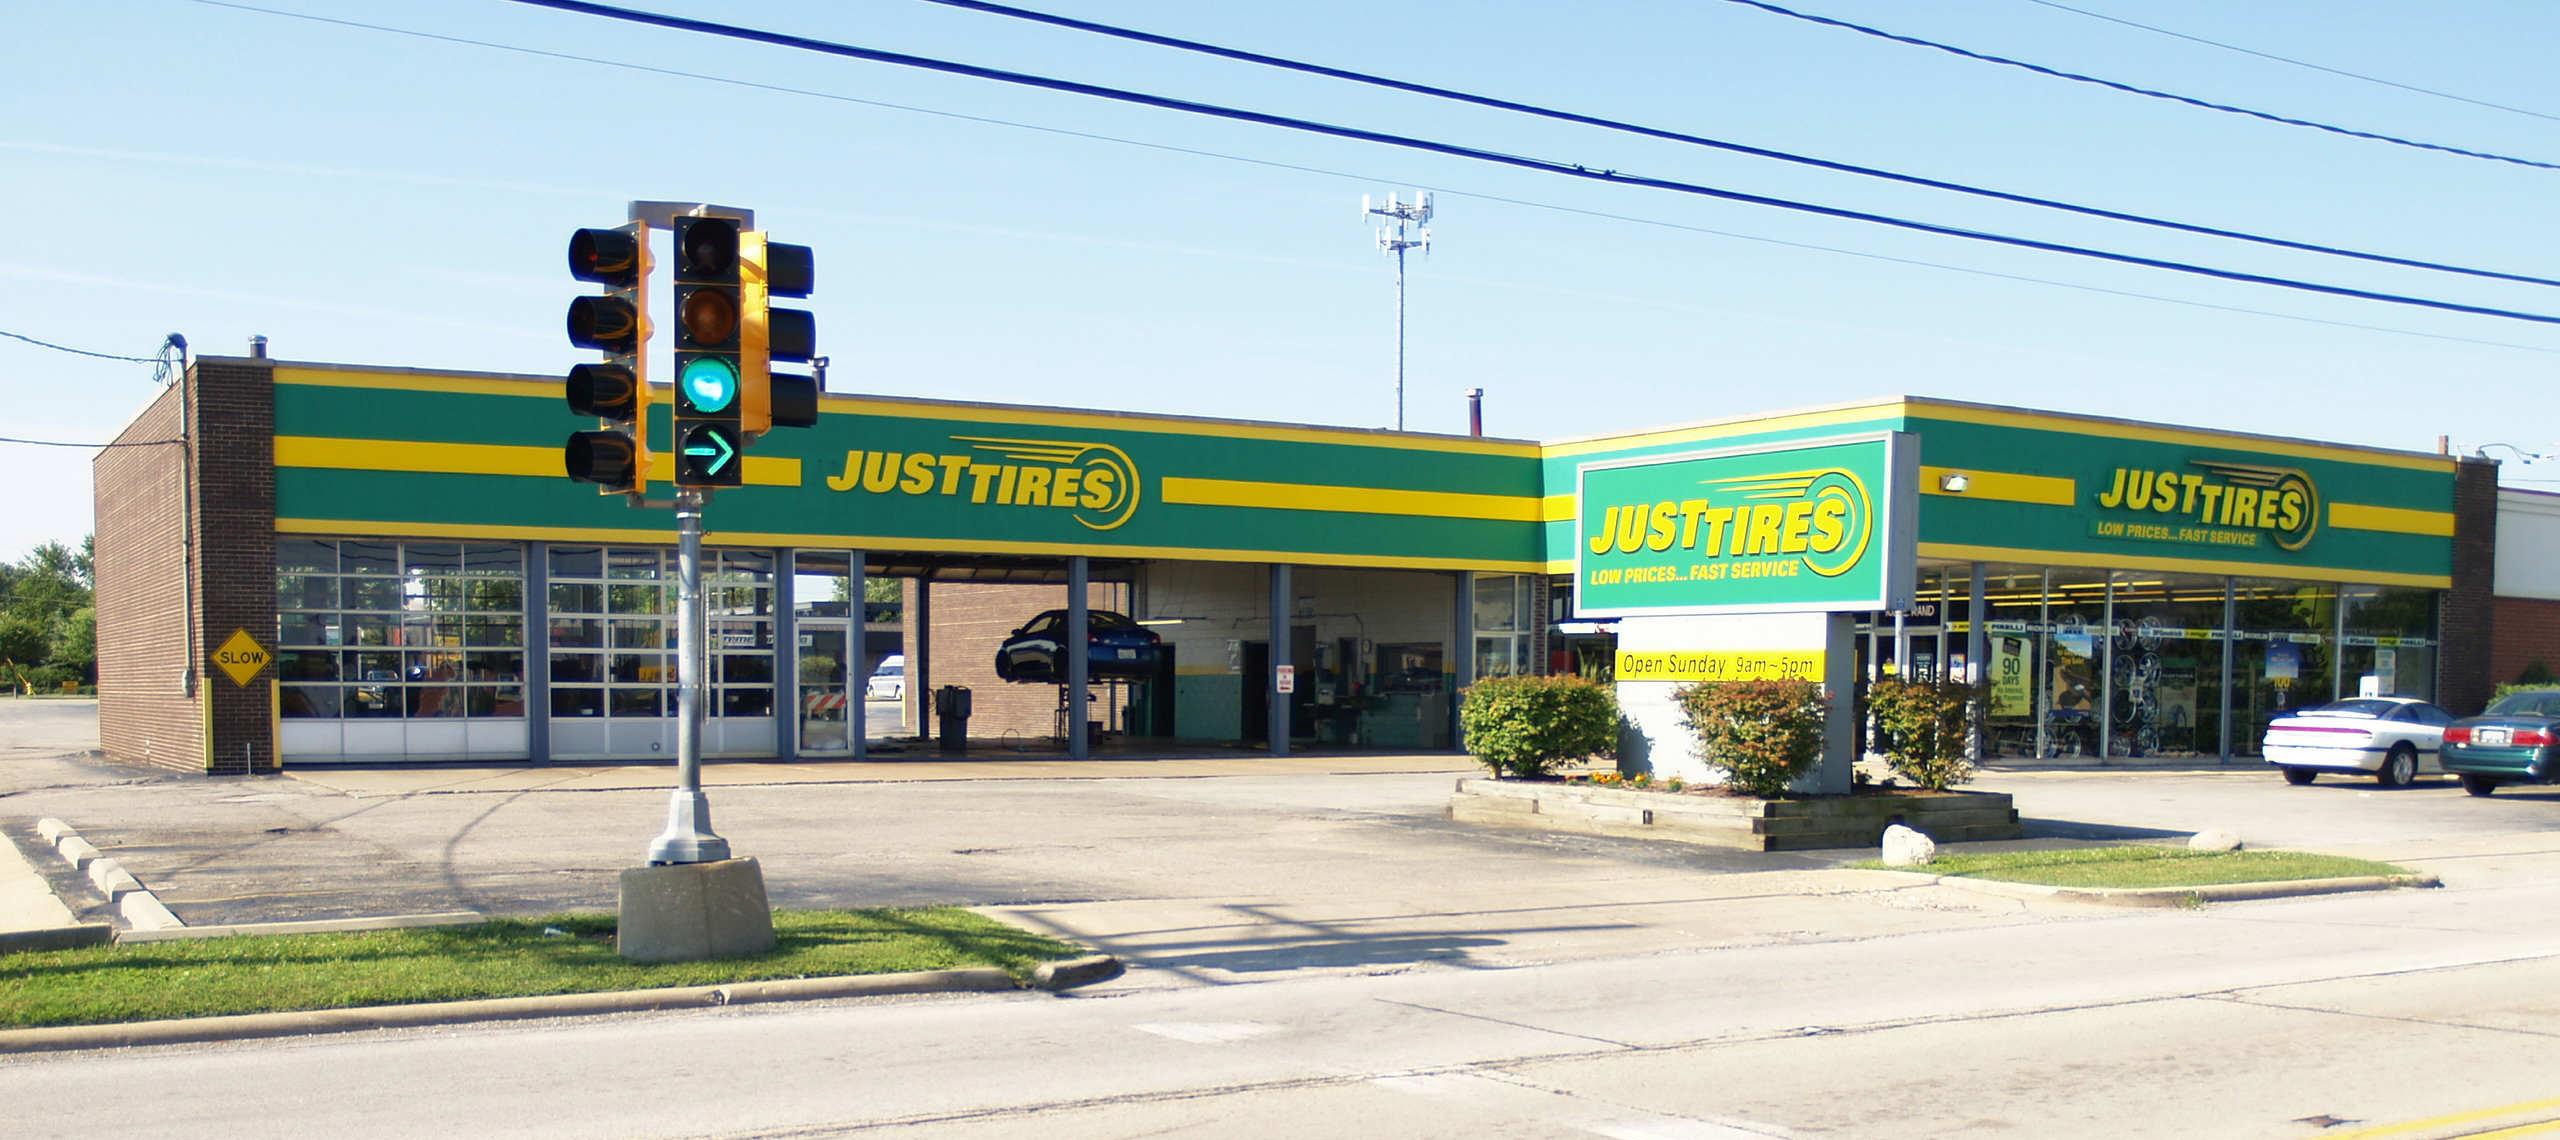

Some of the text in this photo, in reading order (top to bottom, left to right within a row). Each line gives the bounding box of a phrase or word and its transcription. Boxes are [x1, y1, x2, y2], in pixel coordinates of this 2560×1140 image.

[826, 449, 1115, 509] JUST TIRES
[2100, 468, 2302, 531] JUST TIRES
[1590, 498, 1846, 557] JUST TIRES
[2097, 521, 2123, 537] LOW
[2179, 528, 2208, 542] FAST
[2209, 531, 2257, 546] SERVICE
[1590, 568, 1622, 585] LOW
[1690, 562, 1729, 580] FAST
[1730, 559, 1800, 579] SERVICE
[1903, 605, 1935, 617] RAND
[220, 652, 264, 664] SLOW
[1623, 655, 1663, 678] Open
[1668, 655, 1726, 678] Sunday
[2002, 657, 2021, 675] 90
[2002, 675, 2020, 686] DAYS
